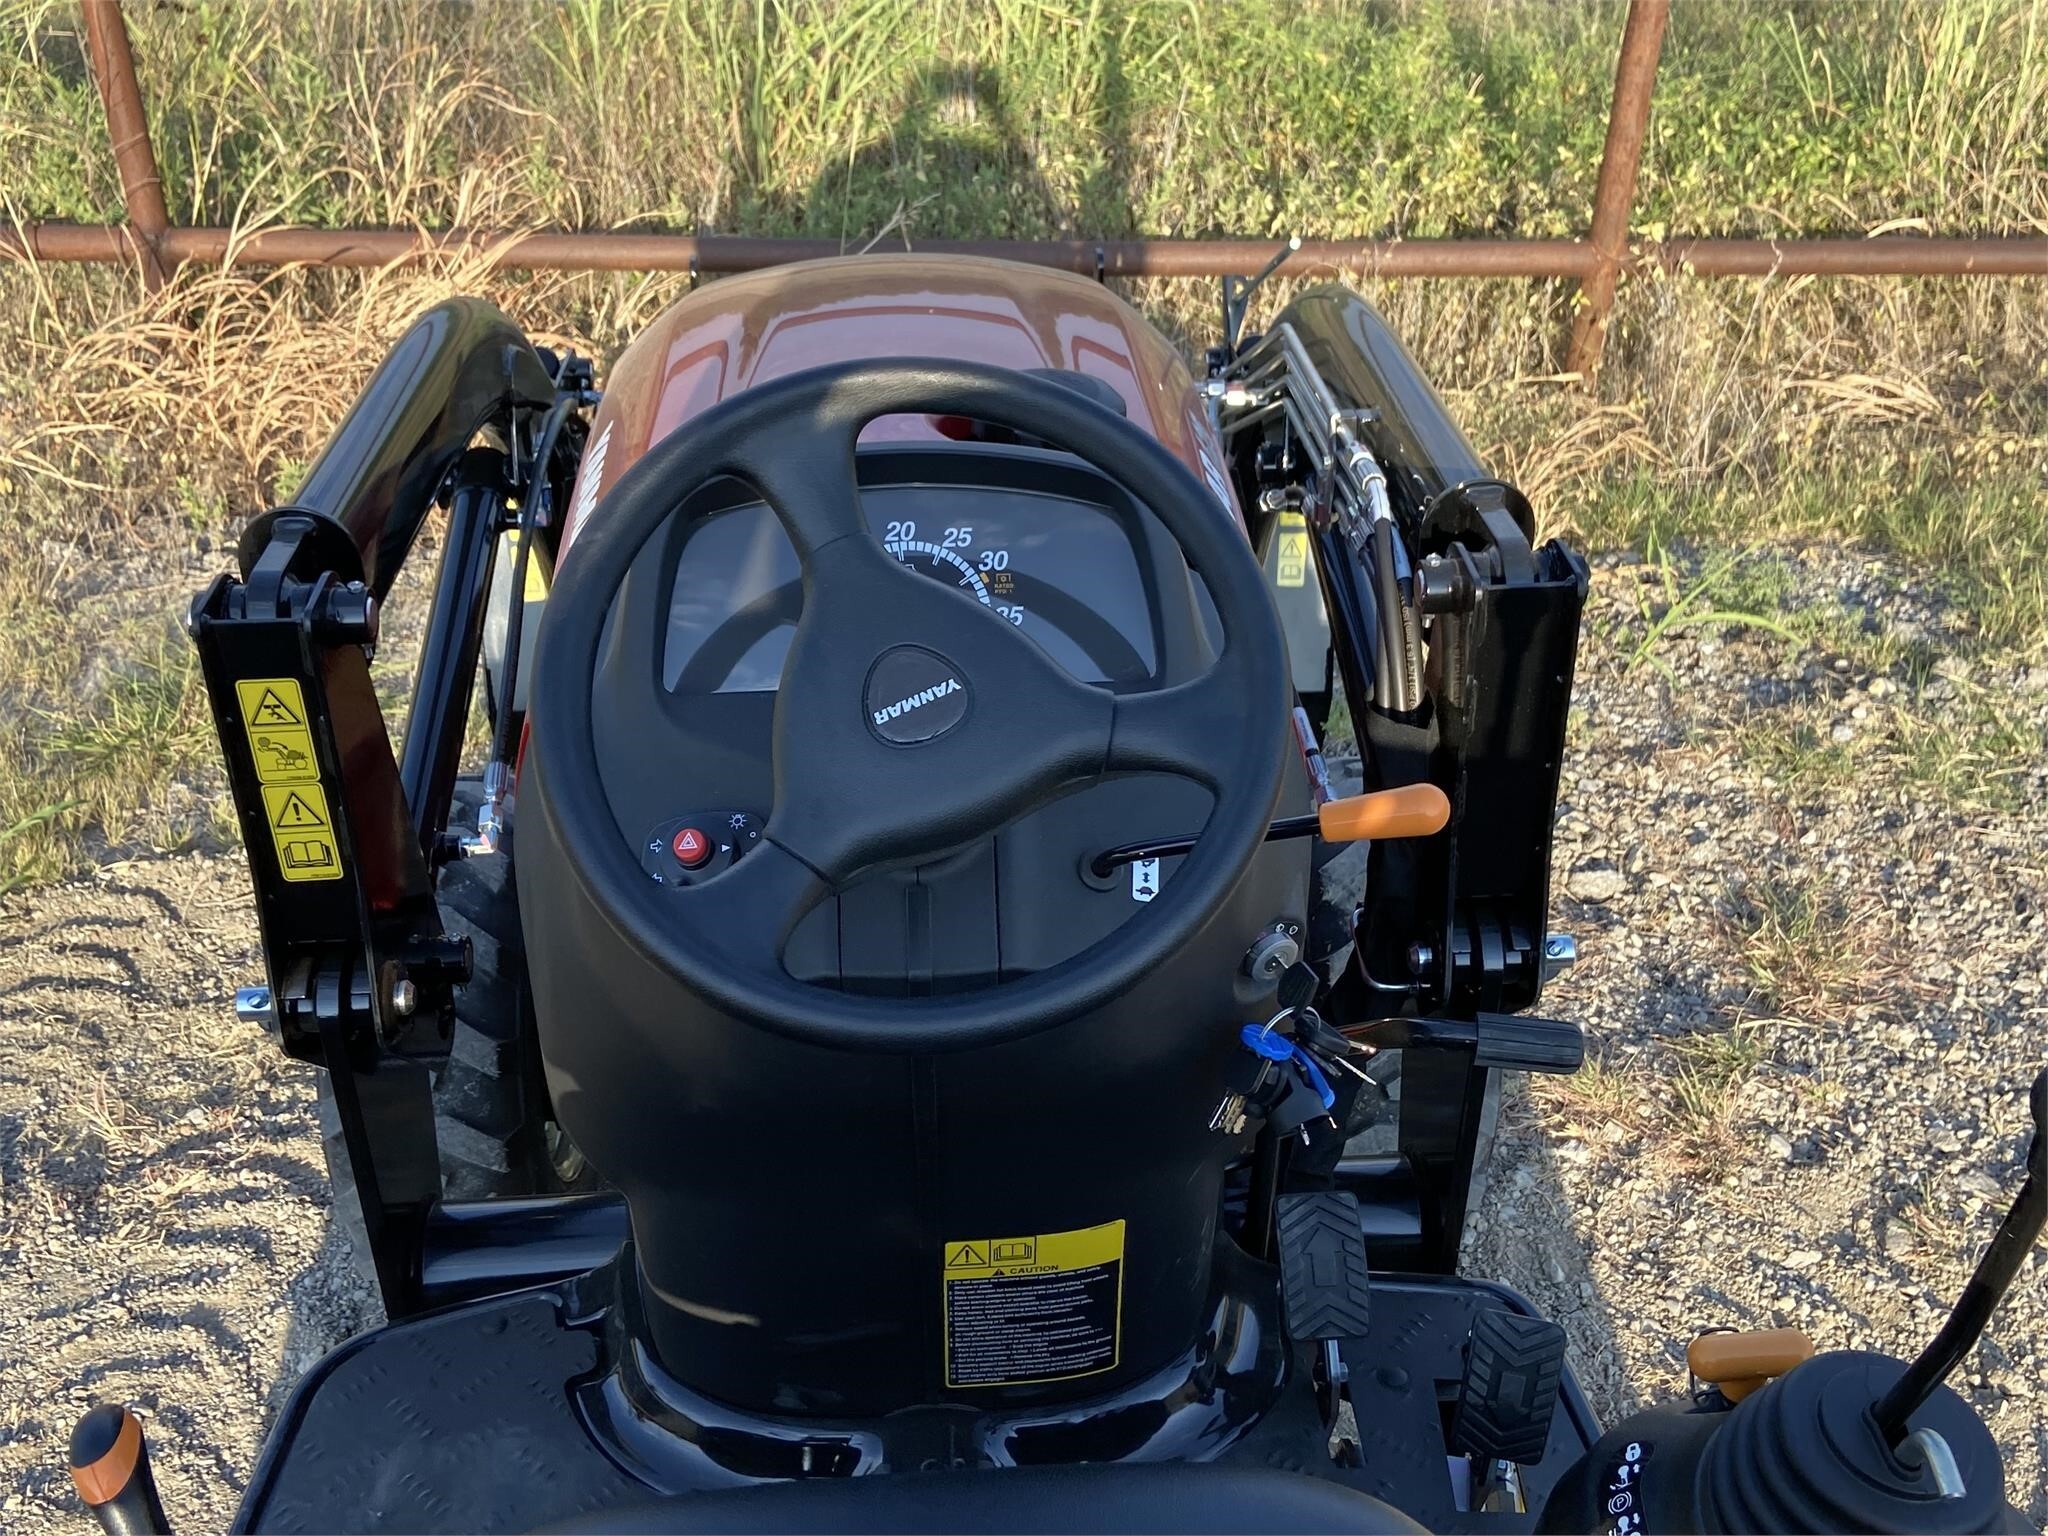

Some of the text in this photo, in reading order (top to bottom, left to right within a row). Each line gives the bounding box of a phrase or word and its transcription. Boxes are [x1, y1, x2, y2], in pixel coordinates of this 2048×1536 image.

[885, 521, 915, 541] 20
[942, 527, 973, 548] 25
[978, 550, 1009, 571] 30
[873, 678, 962, 725] YANMAR
[1009, 1264, 1059, 1275] CAUTION
